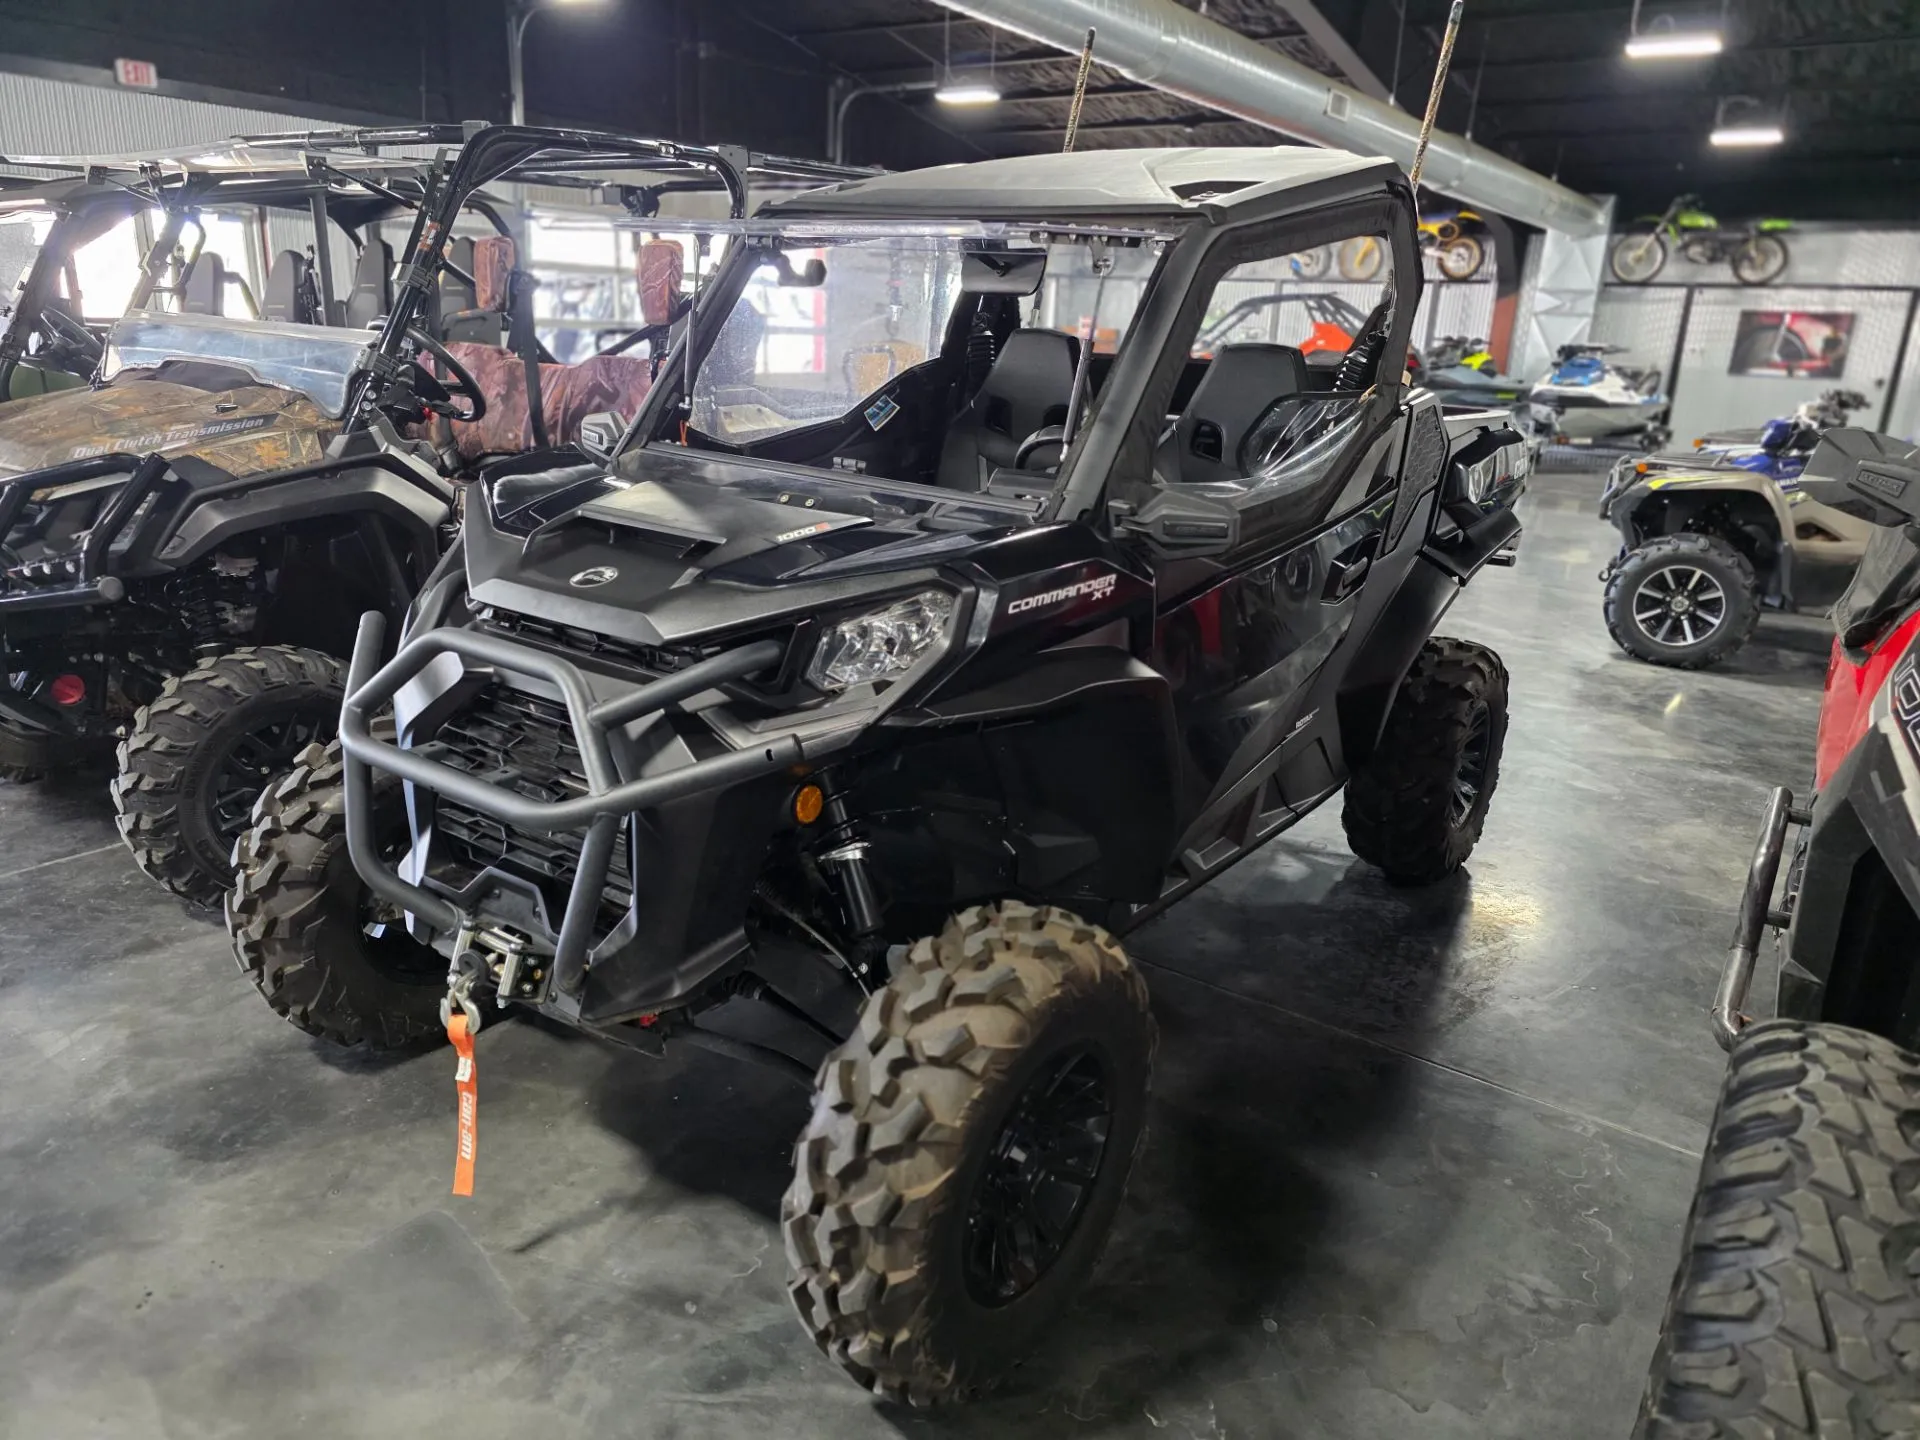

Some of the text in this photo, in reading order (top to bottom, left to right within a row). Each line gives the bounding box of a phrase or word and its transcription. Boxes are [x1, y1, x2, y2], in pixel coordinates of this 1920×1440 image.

[124, 61, 151, 85] EXIT
[74, 418, 264, 459] Dual Clutch Transmission
[1008, 573, 1117, 614] COMMANDER
[1091, 586, 1115, 601] XT
